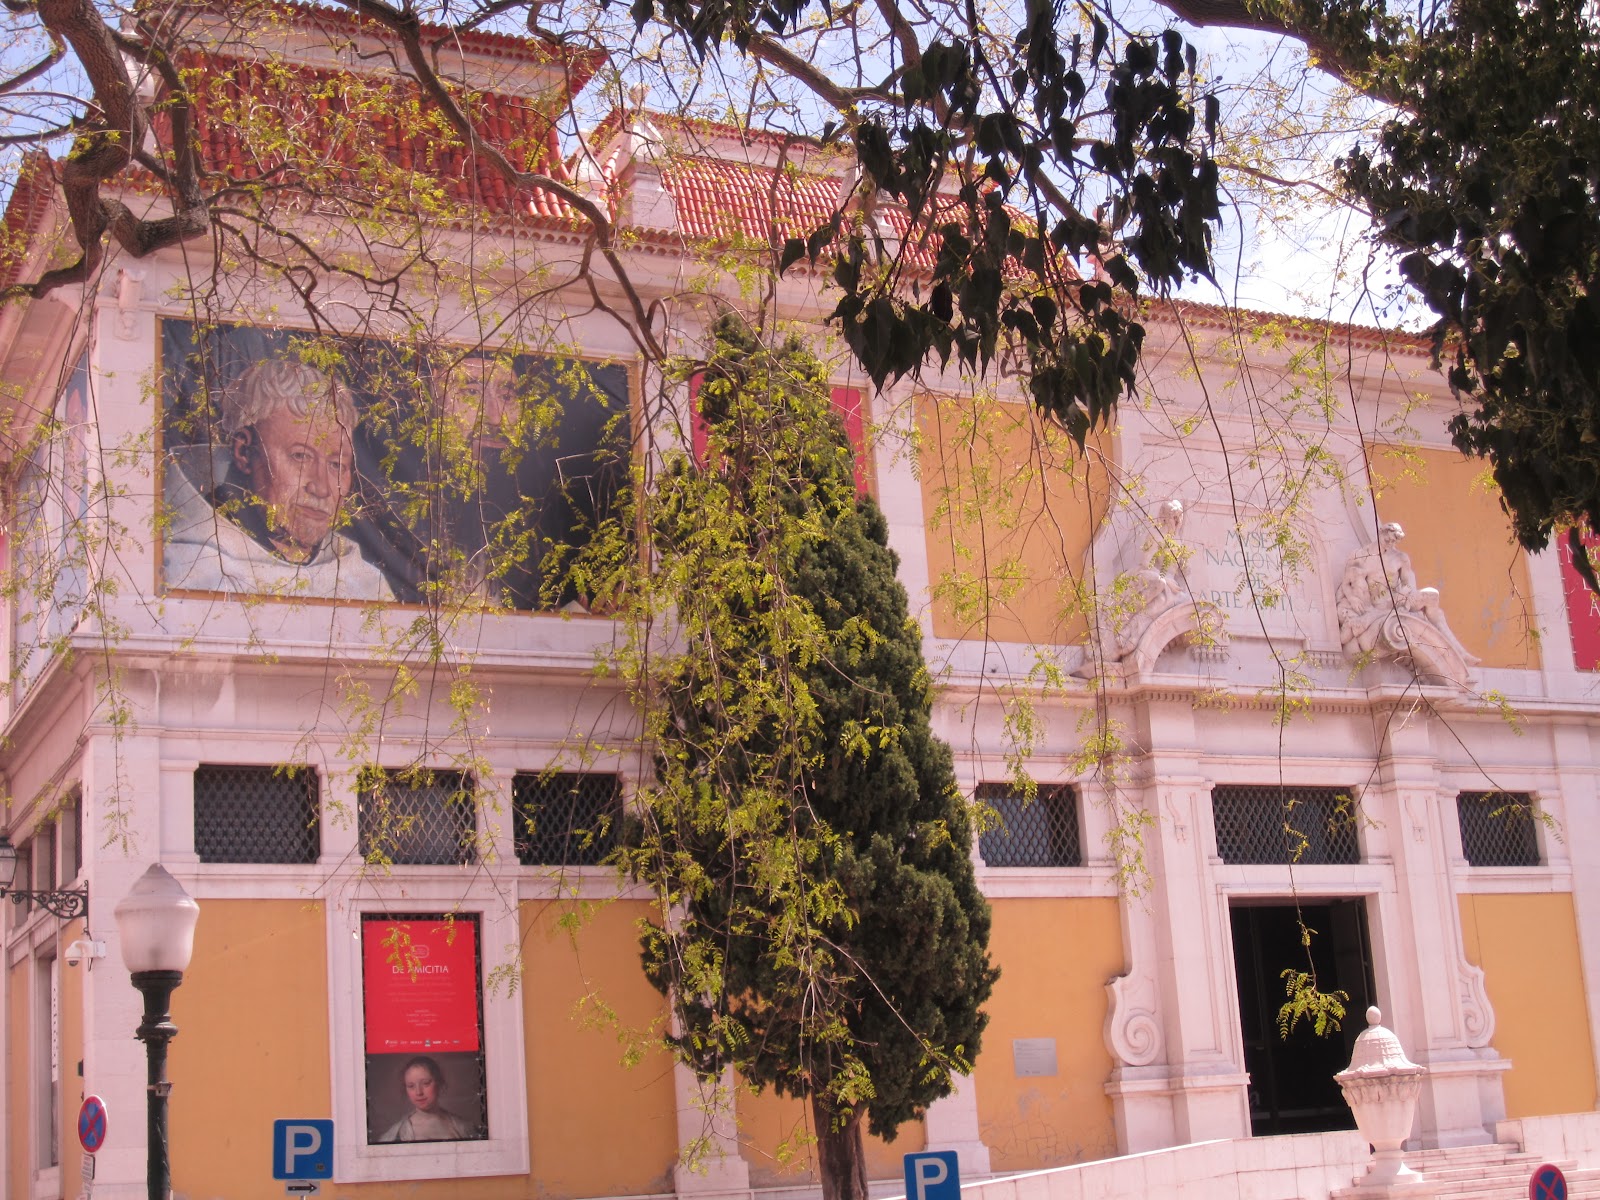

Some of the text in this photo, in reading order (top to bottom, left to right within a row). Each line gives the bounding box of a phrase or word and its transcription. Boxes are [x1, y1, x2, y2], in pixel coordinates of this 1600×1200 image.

[1199, 589, 1243, 609] ARTE
[392, 965, 405, 974] DE
[285, 1125, 322, 1174] P
[915, 1157, 948, 1200] P
